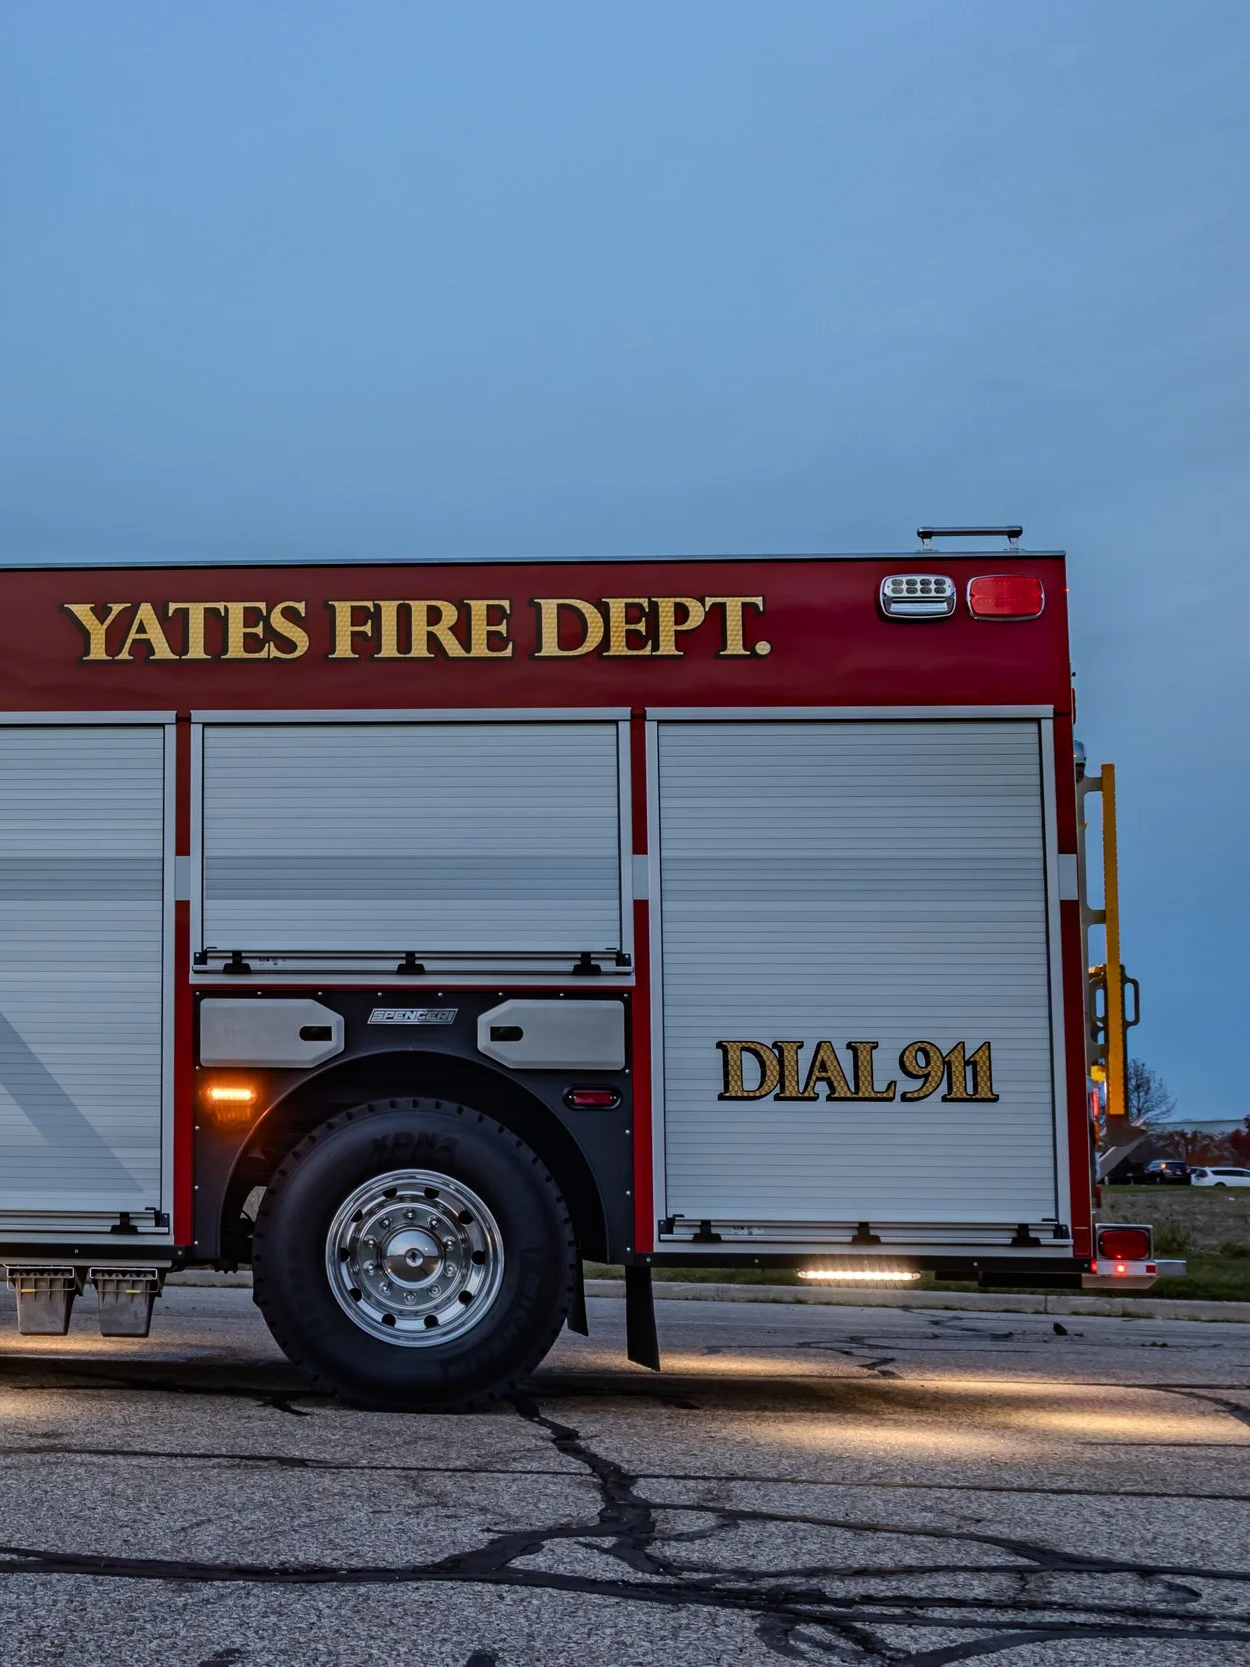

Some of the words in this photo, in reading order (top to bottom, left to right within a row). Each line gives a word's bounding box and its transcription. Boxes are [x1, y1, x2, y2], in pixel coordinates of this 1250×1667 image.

[62, 600, 310, 661] YATES
[327, 599, 514, 660] FIRE
[533, 596, 773, 658] DEPT.
[716, 1040, 896, 1103] DIAL
[899, 1041, 1000, 1104] 911
